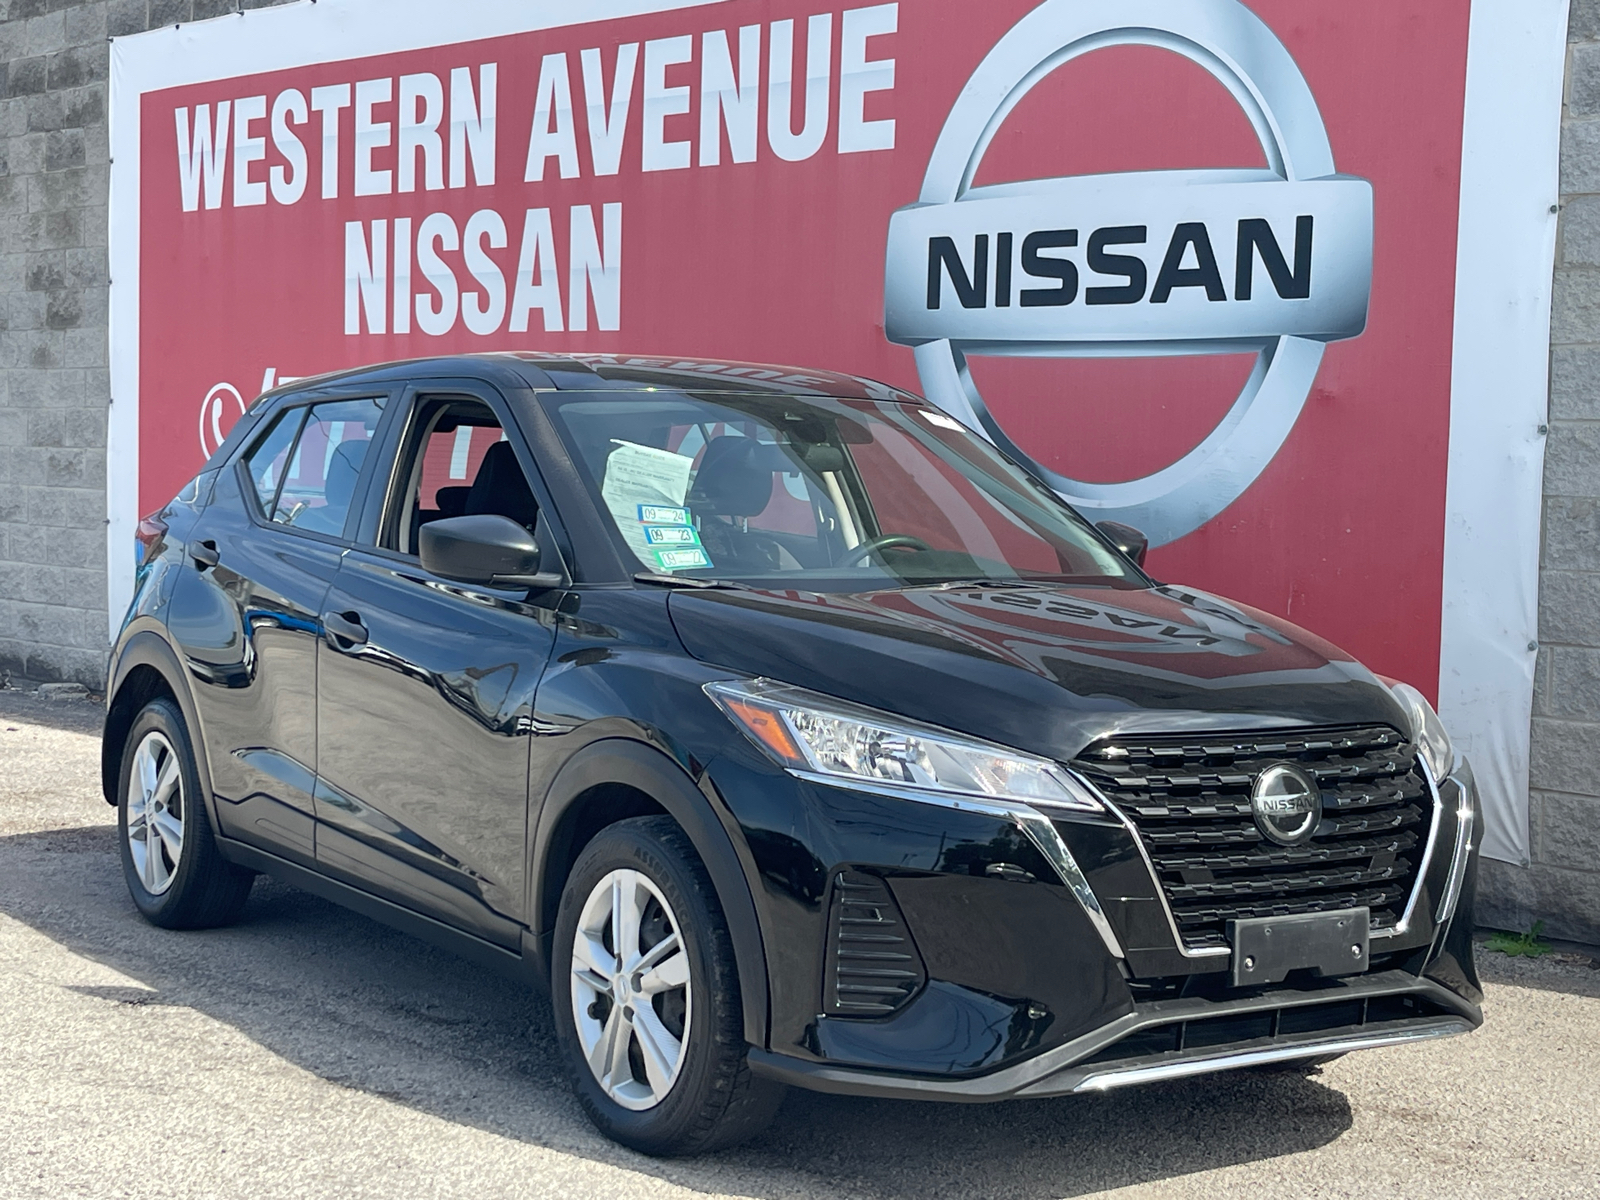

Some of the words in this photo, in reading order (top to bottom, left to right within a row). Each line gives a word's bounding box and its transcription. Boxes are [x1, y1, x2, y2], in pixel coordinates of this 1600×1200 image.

[175, 62, 497, 212] WESTERN
[524, 2, 898, 182] AVENUE
[344, 202, 622, 336] NISSAN
[927, 215, 1313, 309] NISSAN
[644, 508, 656, 519] 09
[672, 510, 684, 522] 24
[650, 529, 664, 541] 09
[678, 529, 691, 541] 23
[1263, 796, 1313, 811] NISSAN
